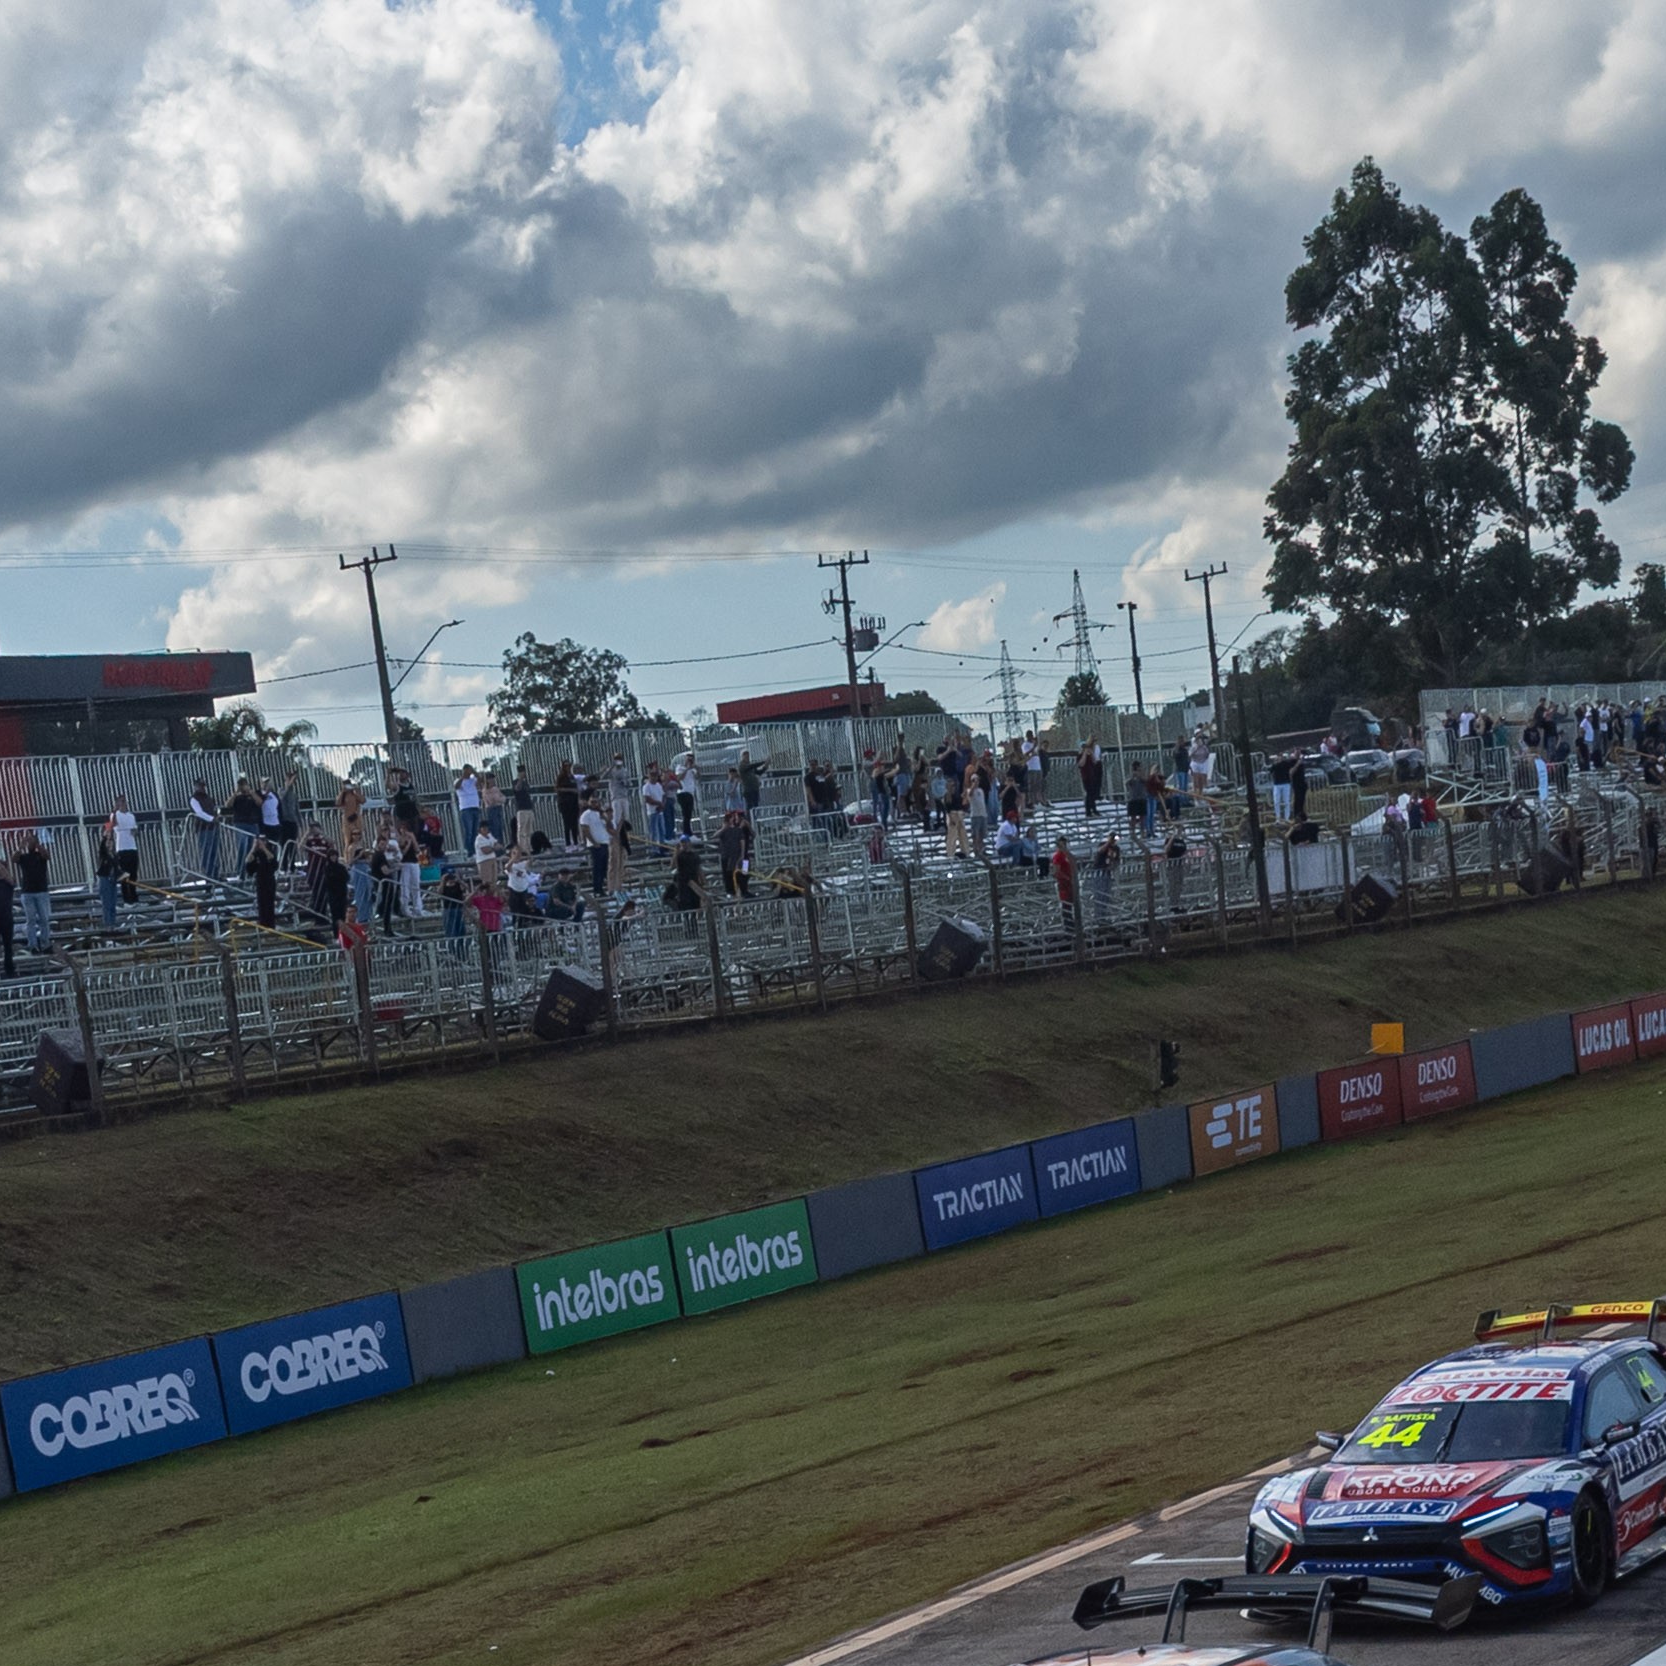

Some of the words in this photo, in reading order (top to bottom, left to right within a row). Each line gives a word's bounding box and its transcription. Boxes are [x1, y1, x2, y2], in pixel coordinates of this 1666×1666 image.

[1579, 1027, 1612, 1056] LUCAS
[1614, 1017, 1630, 1048] OIL
[1418, 1056, 1456, 1085] DENSO
[1340, 1073, 1382, 1103] DENSO
[1235, 1095, 1262, 1141] TE
[1047, 1145, 1127, 1189] TRACTIAN
[932, 1172, 1023, 1222] TRACTIAN
[686, 1229, 802, 1293] intelbras
[533, 1264, 664, 1331] intelbras
[1590, 1304, 1645, 1314] GENCO
[240, 1324, 389, 1403] COBREQ
[1414, 1369, 1567, 1383] Caravelas
[1637, 1368, 1654, 1388] 44
[1389, 1382, 1569, 1403] LOCTITE
[30, 1373, 200, 1457] COBREQ
[1382, 1412, 1436, 1423] BAPTISTA
[1357, 1421, 1426, 1448] 44
[1345, 1472, 1477, 1488] KRONA
[1389, 1486, 1396, 1494] E
[1314, 1502, 1450, 1518] TAMBASA
